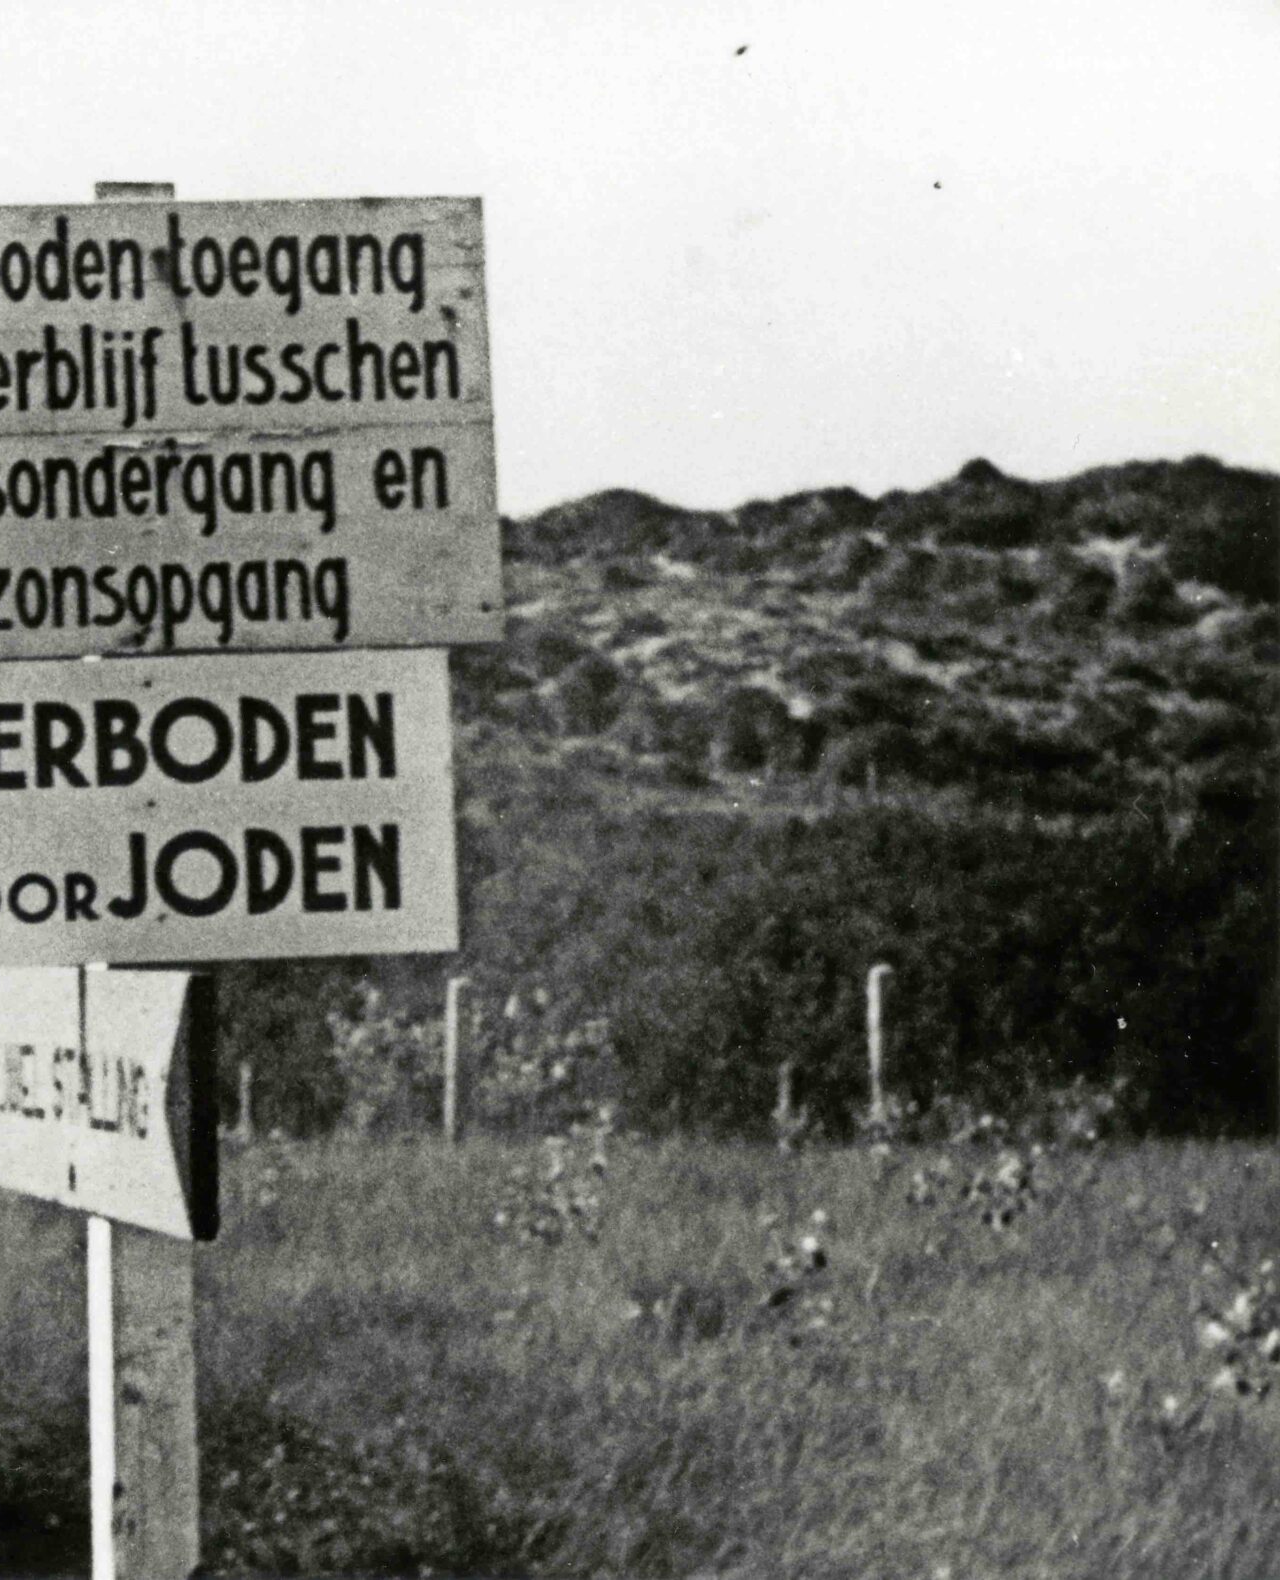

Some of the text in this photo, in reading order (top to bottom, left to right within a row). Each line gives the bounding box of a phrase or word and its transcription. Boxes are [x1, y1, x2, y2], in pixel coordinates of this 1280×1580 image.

[166, 212, 425, 317] toegang
[180, 317, 460, 406] tusschen
[372, 446, 450, 511] en
[107, 823, 401, 920] JODEN
